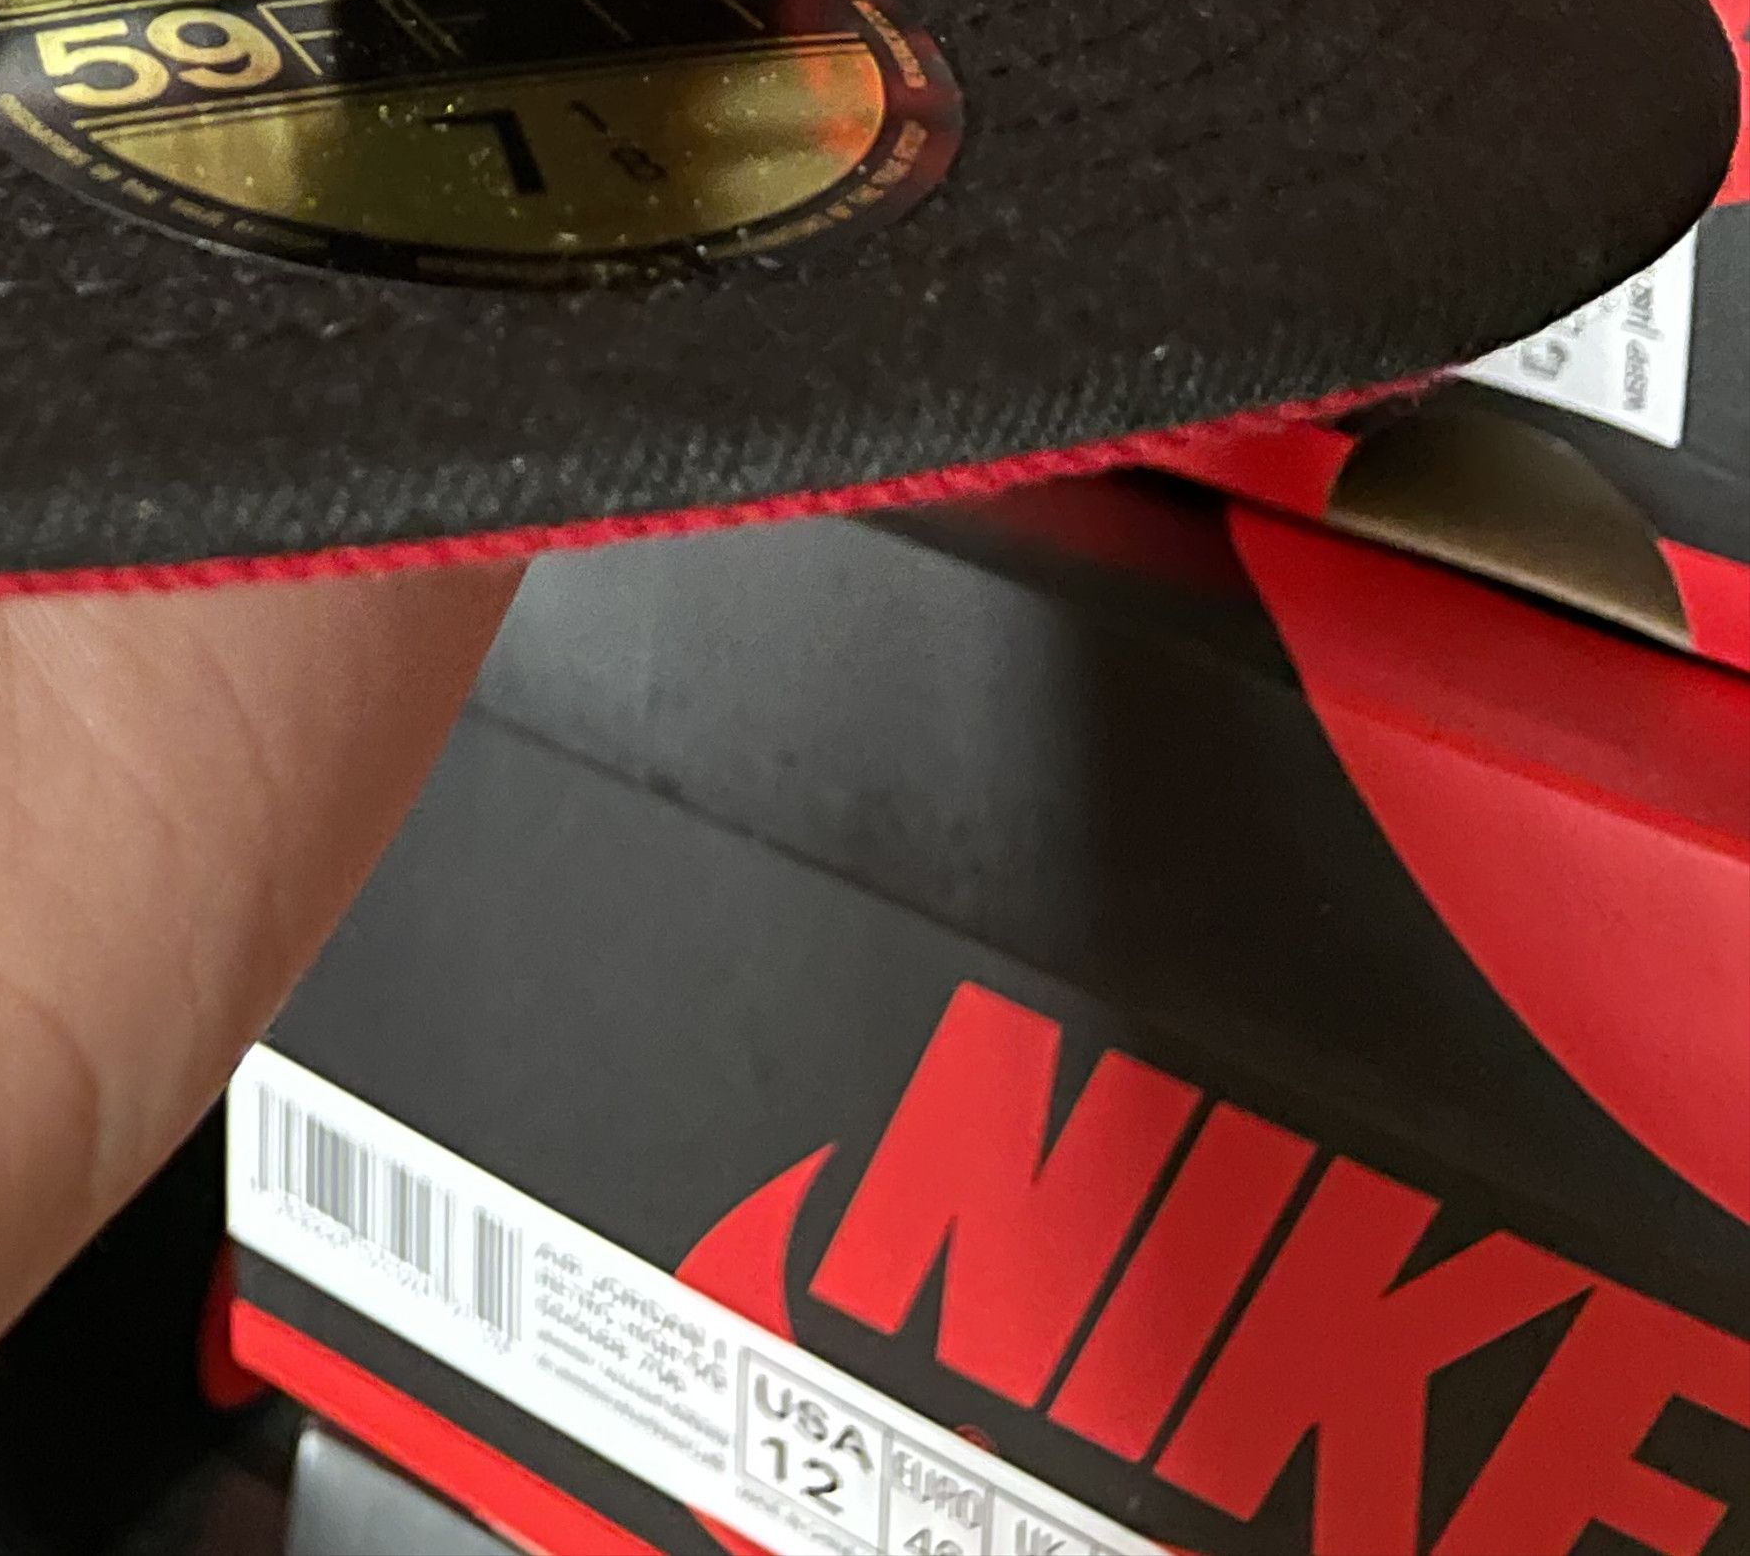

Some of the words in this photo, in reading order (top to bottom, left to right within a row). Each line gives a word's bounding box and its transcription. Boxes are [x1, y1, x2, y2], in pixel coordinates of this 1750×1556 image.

[425, 108, 545, 195] 7
[754, 1374, 873, 1475] USA
[761, 1436, 845, 1516] 12
